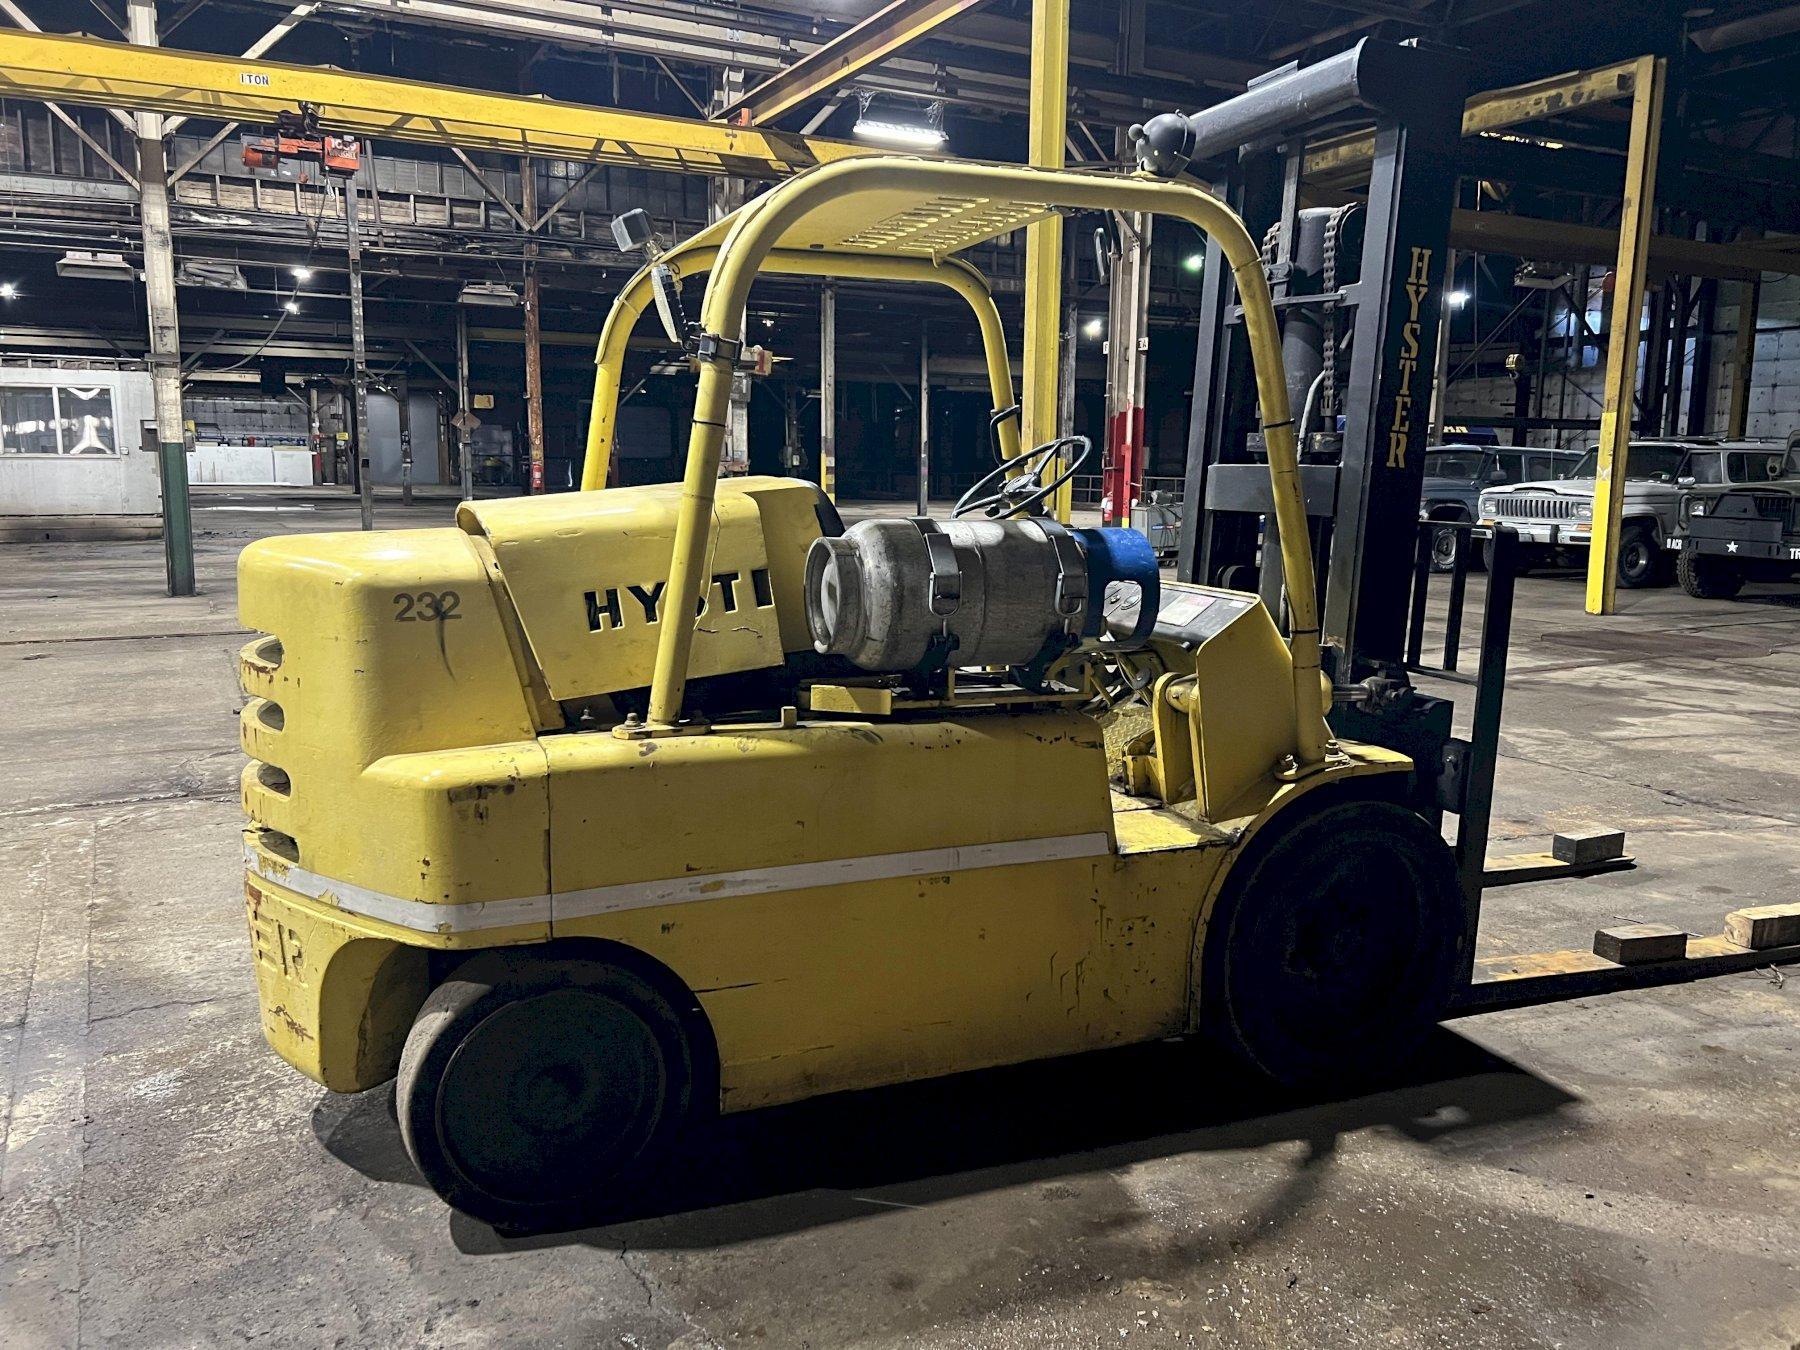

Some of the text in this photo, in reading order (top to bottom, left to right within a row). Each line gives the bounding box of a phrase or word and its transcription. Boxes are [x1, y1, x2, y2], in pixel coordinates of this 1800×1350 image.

[247, 74, 269, 85] TON
[1386, 247, 1433, 469] HYSTER
[392, 590, 463, 623] 232
